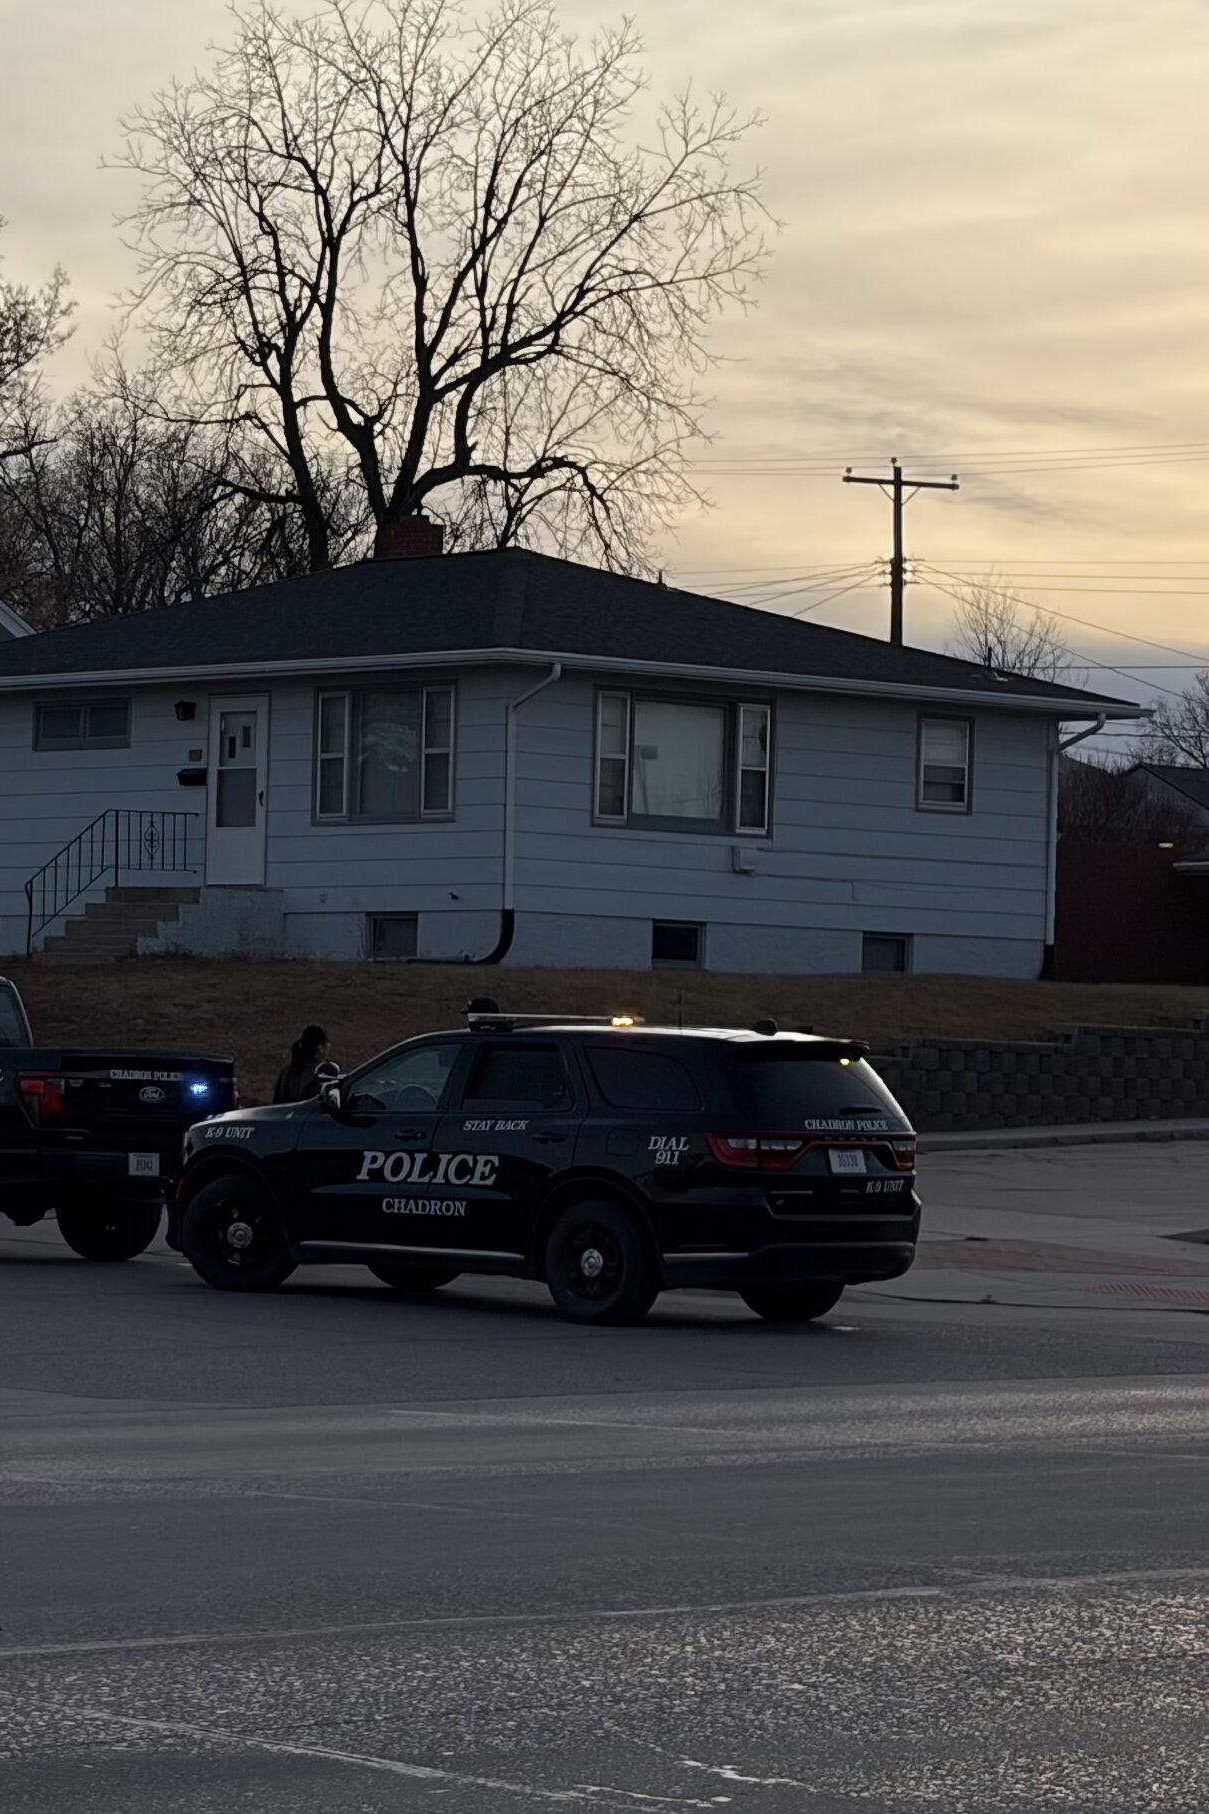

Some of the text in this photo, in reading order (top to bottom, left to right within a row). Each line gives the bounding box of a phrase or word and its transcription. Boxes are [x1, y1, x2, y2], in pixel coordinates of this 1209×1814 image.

[109, 1069, 152, 1080] CHADRON
[462, 1120, 530, 1131] STAY BACK
[804, 1119, 889, 1131] CHADRON POLICE
[204, 1126, 255, 1139] K-9 UNIT
[647, 1135, 690, 1151] DIAL
[654, 1150, 680, 1165] 911
[355, 1150, 500, 1186] POLICE
[883, 1179, 905, 1193] UNIT
[381, 1198, 468, 1216] CHADRON
